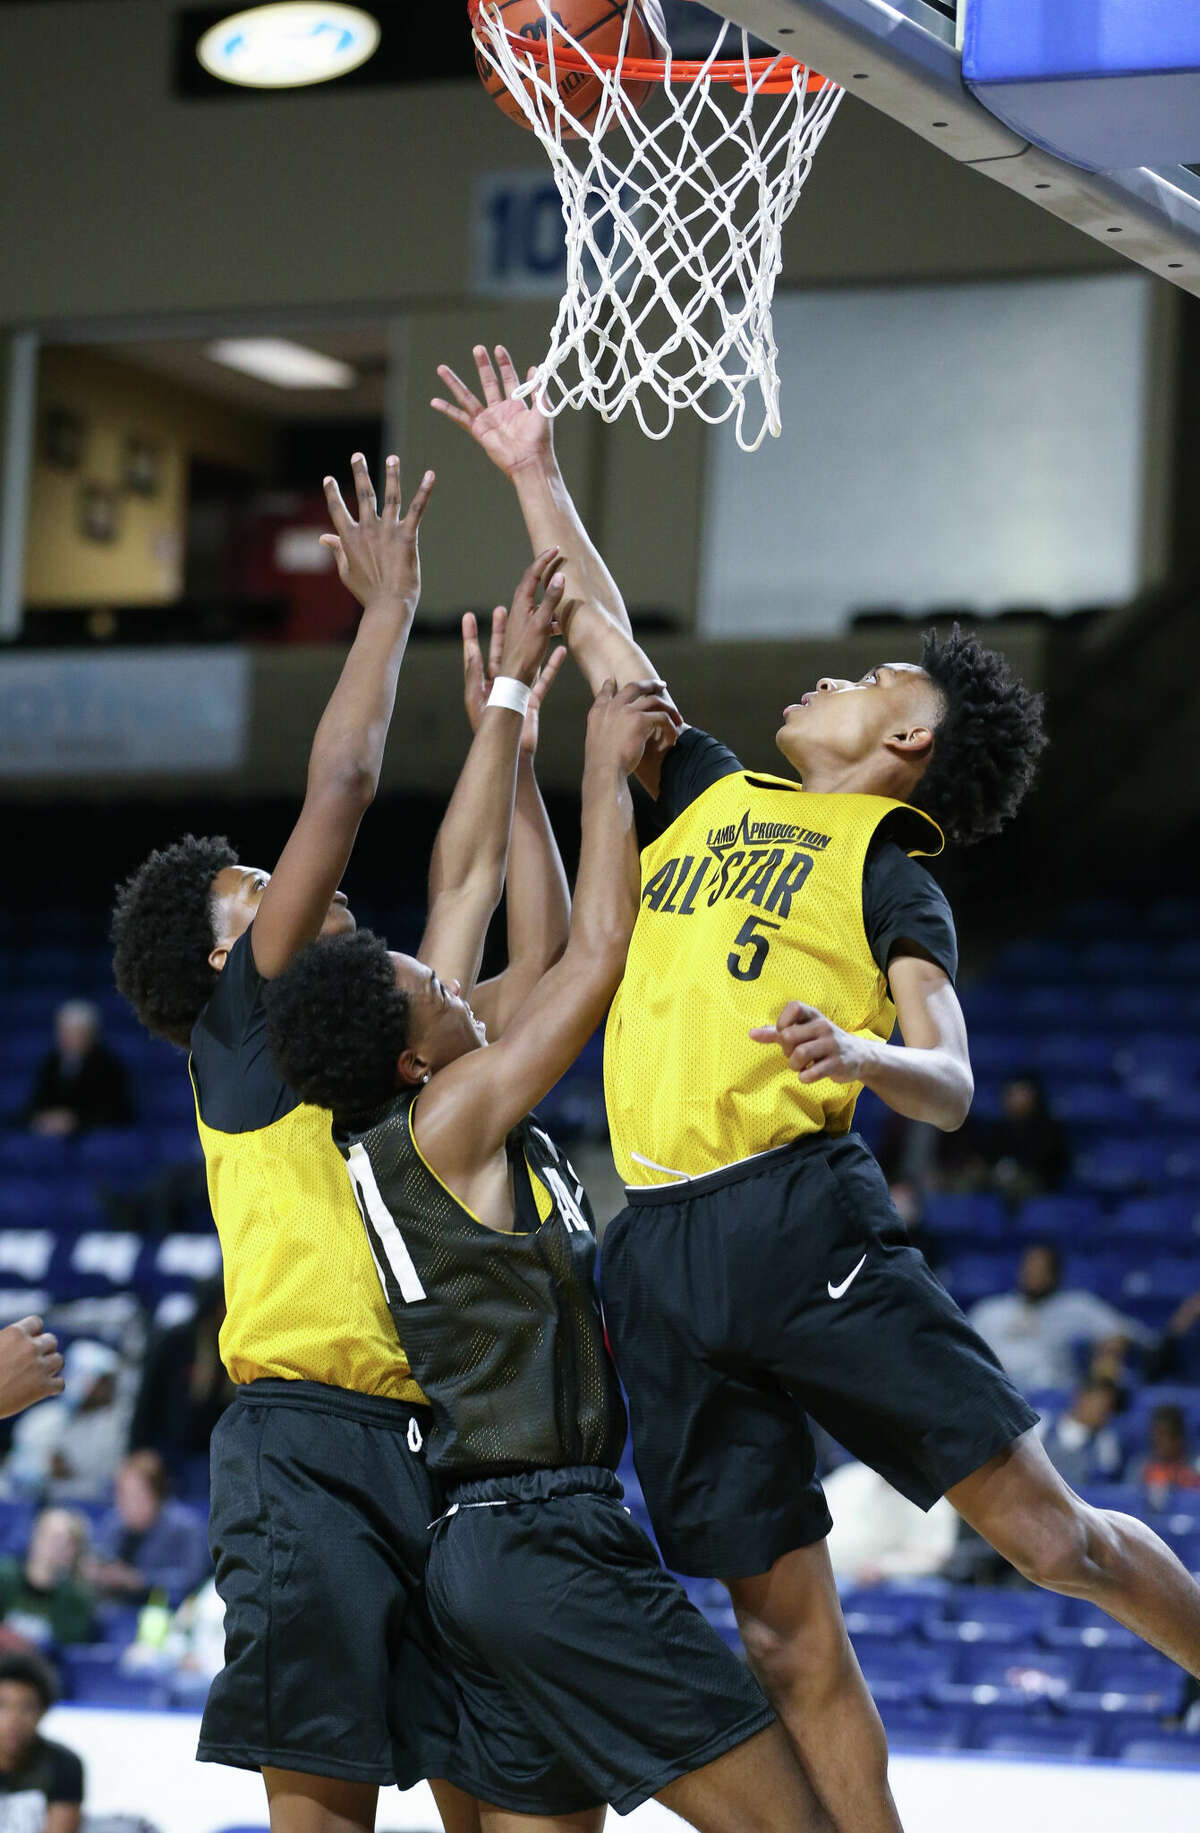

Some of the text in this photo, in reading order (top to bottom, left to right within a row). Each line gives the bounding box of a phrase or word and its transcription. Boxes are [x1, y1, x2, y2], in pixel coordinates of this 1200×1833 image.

[706, 822, 833, 849] LAMB PRODUCTION
[642, 848, 814, 919] ALL STAR
[727, 914, 781, 981] 5
[346, 1142, 427, 1304] 1
